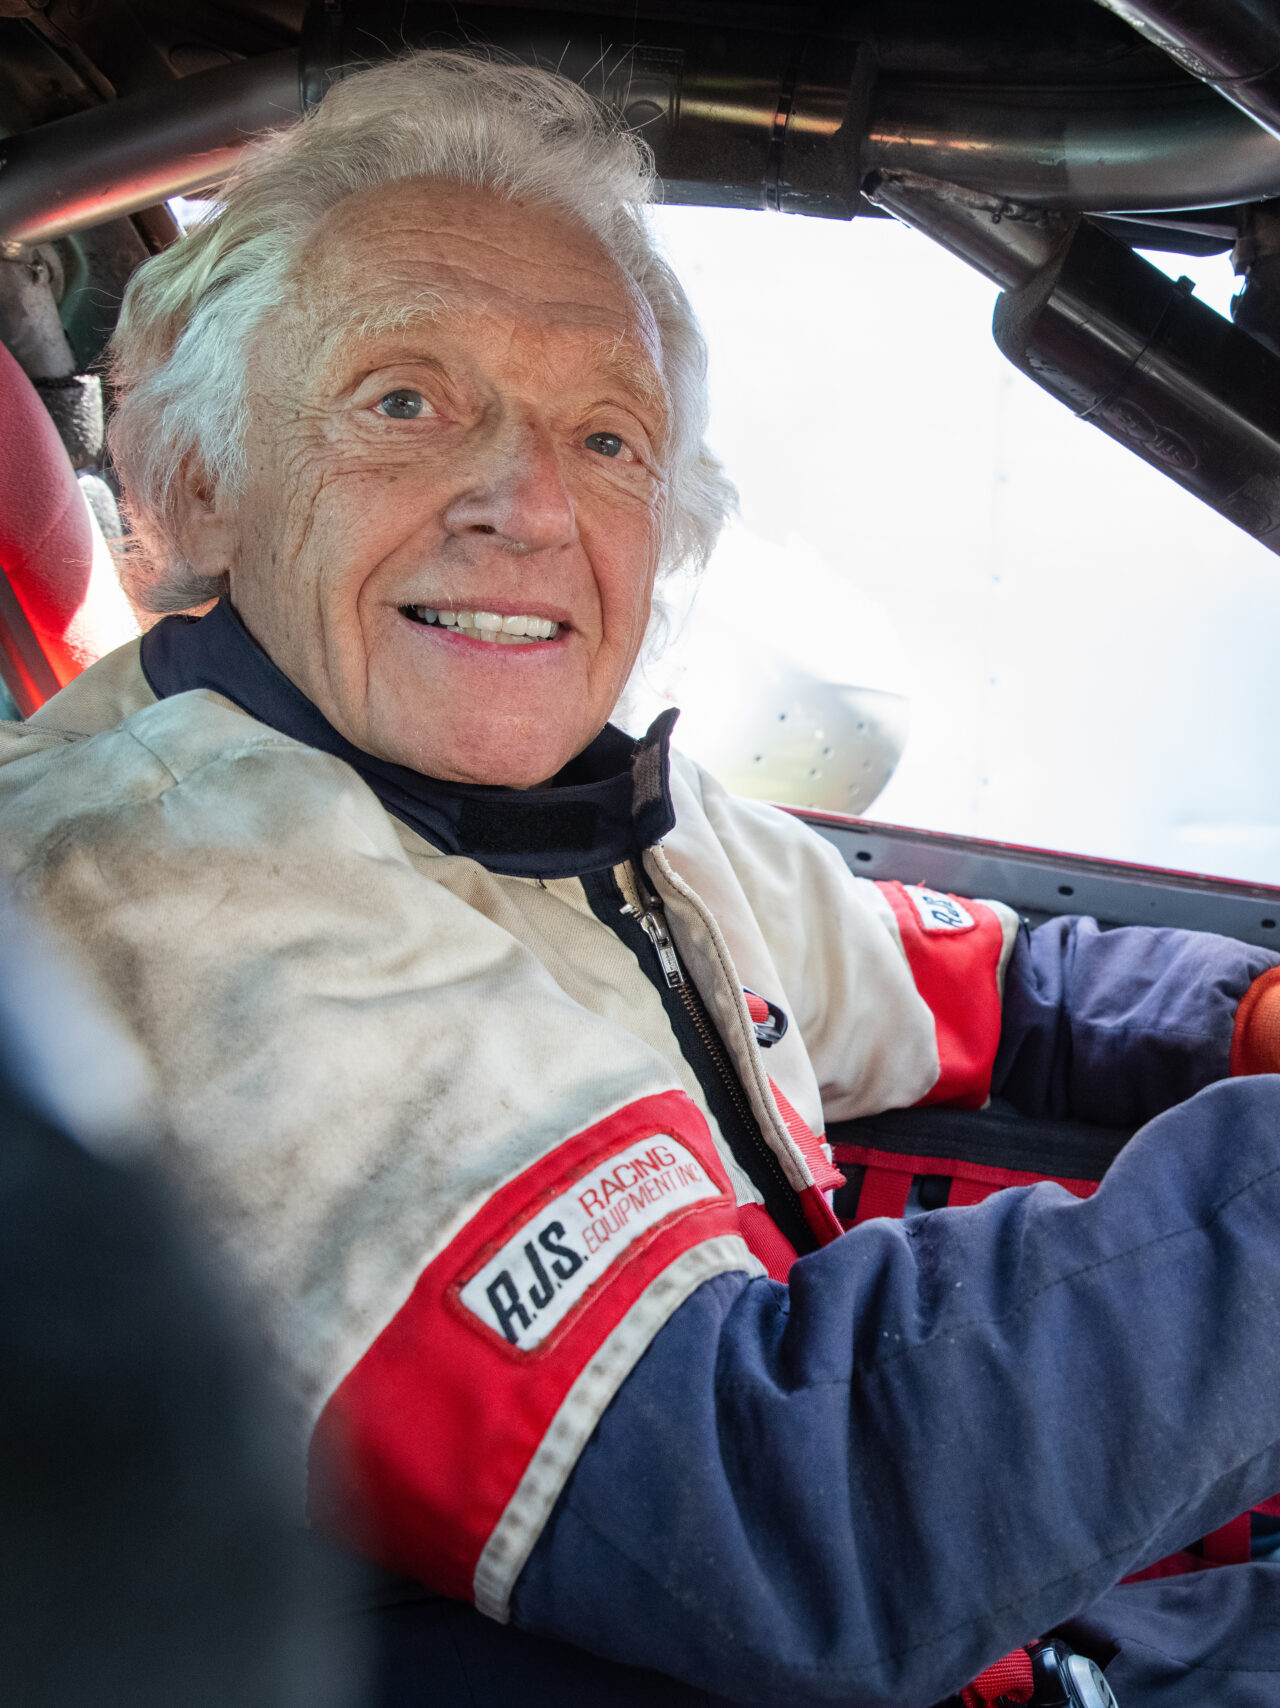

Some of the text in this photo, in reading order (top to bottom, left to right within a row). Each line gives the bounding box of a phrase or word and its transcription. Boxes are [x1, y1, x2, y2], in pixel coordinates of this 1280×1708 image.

[577, 1145, 677, 1218] RACING
[581, 1171, 678, 1255] EQUIPMENT
[485, 1220, 590, 1346] R.J.S.
